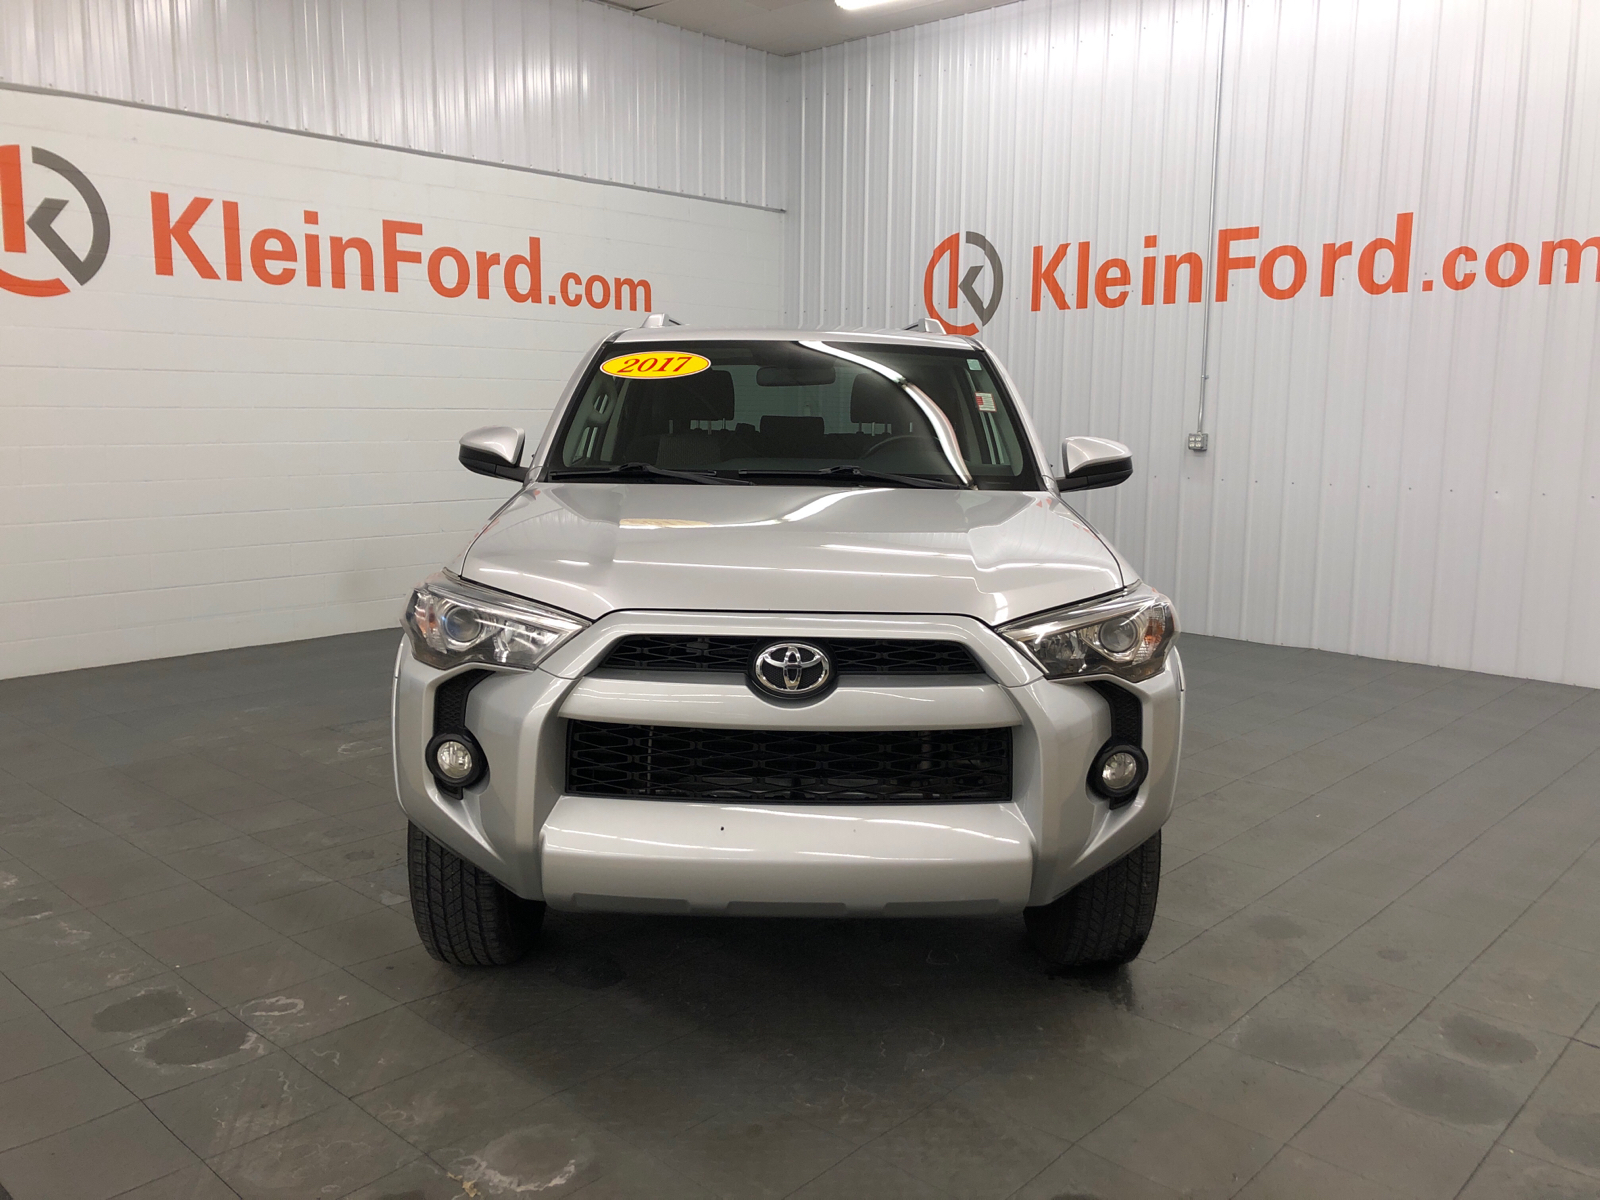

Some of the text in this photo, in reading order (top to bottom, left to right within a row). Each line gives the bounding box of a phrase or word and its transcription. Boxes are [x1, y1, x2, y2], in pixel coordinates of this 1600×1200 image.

[150, 191, 652, 313] KleinFord.com
[1031, 212, 1600, 312] KleinFord.com
[617, 356, 693, 374] 2017
